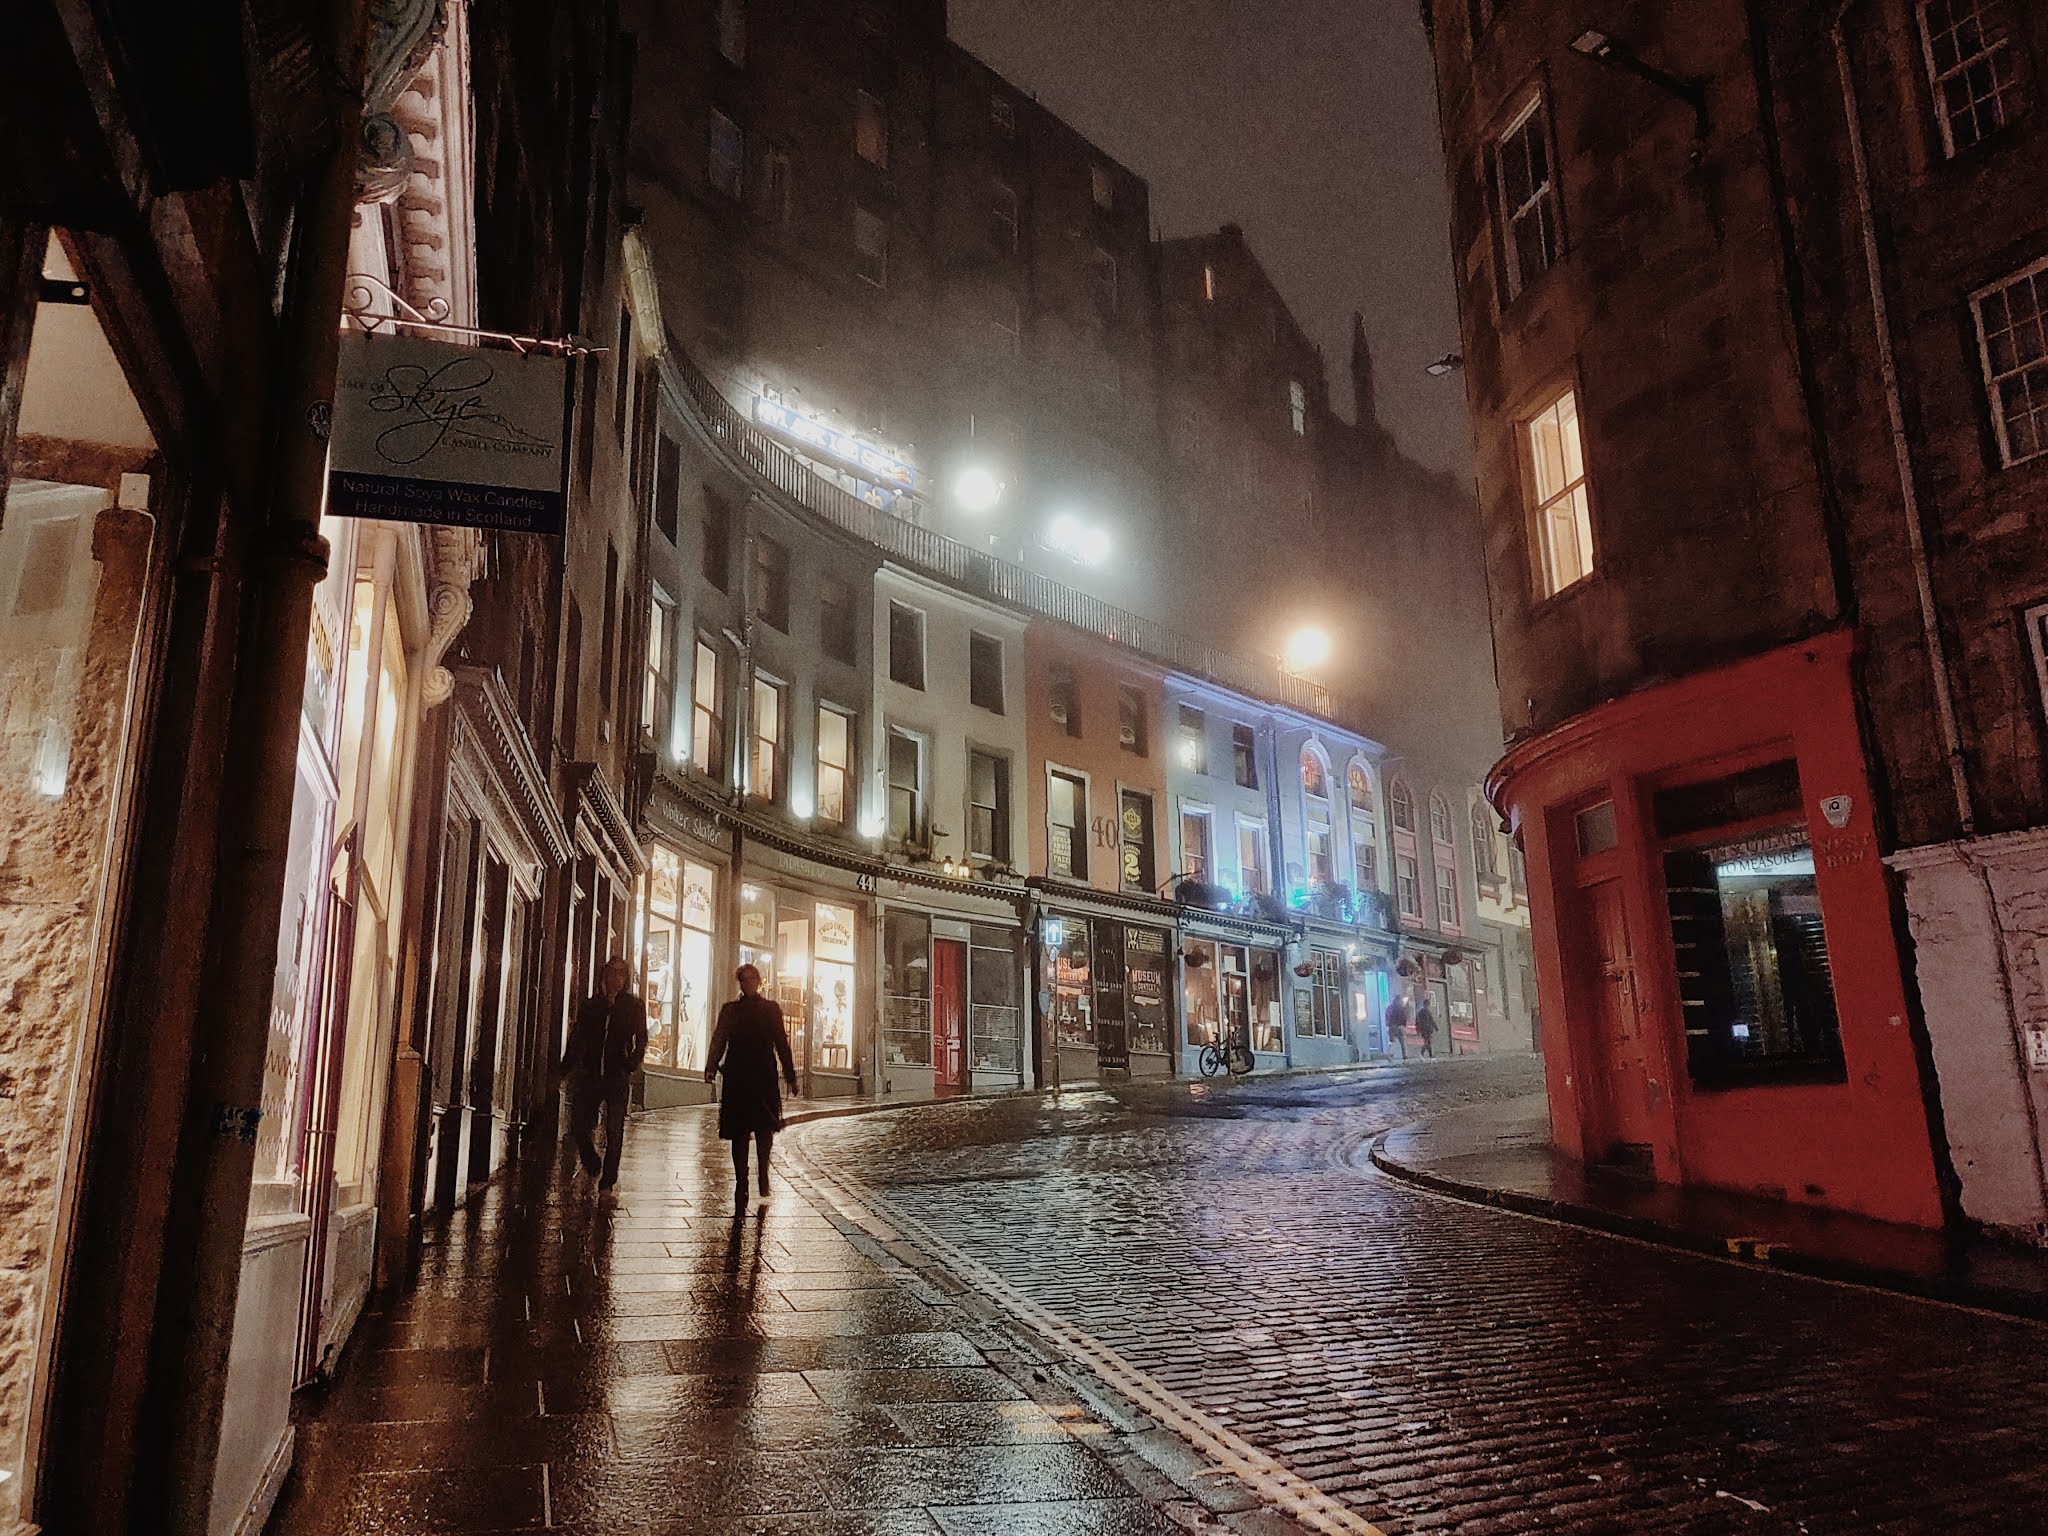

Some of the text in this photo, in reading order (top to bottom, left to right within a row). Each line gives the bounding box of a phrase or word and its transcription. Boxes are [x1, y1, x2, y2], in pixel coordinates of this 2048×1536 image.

[492, 441, 552, 458] COMPANY
[343, 478, 545, 511] Natural Soya Wax Candles
[355, 500, 532, 528] Handmade in Scotland
[312, 602, 334, 679] COTTISH
[693, 818, 721, 844] Slater
[1091, 816, 1117, 849] 40
[1124, 853, 1140, 876] 2
[1720, 851, 1799, 875] TO MEASURE
[1132, 969, 1161, 986] MUSEUM
[1137, 982, 1156, 991] CONTEXT
